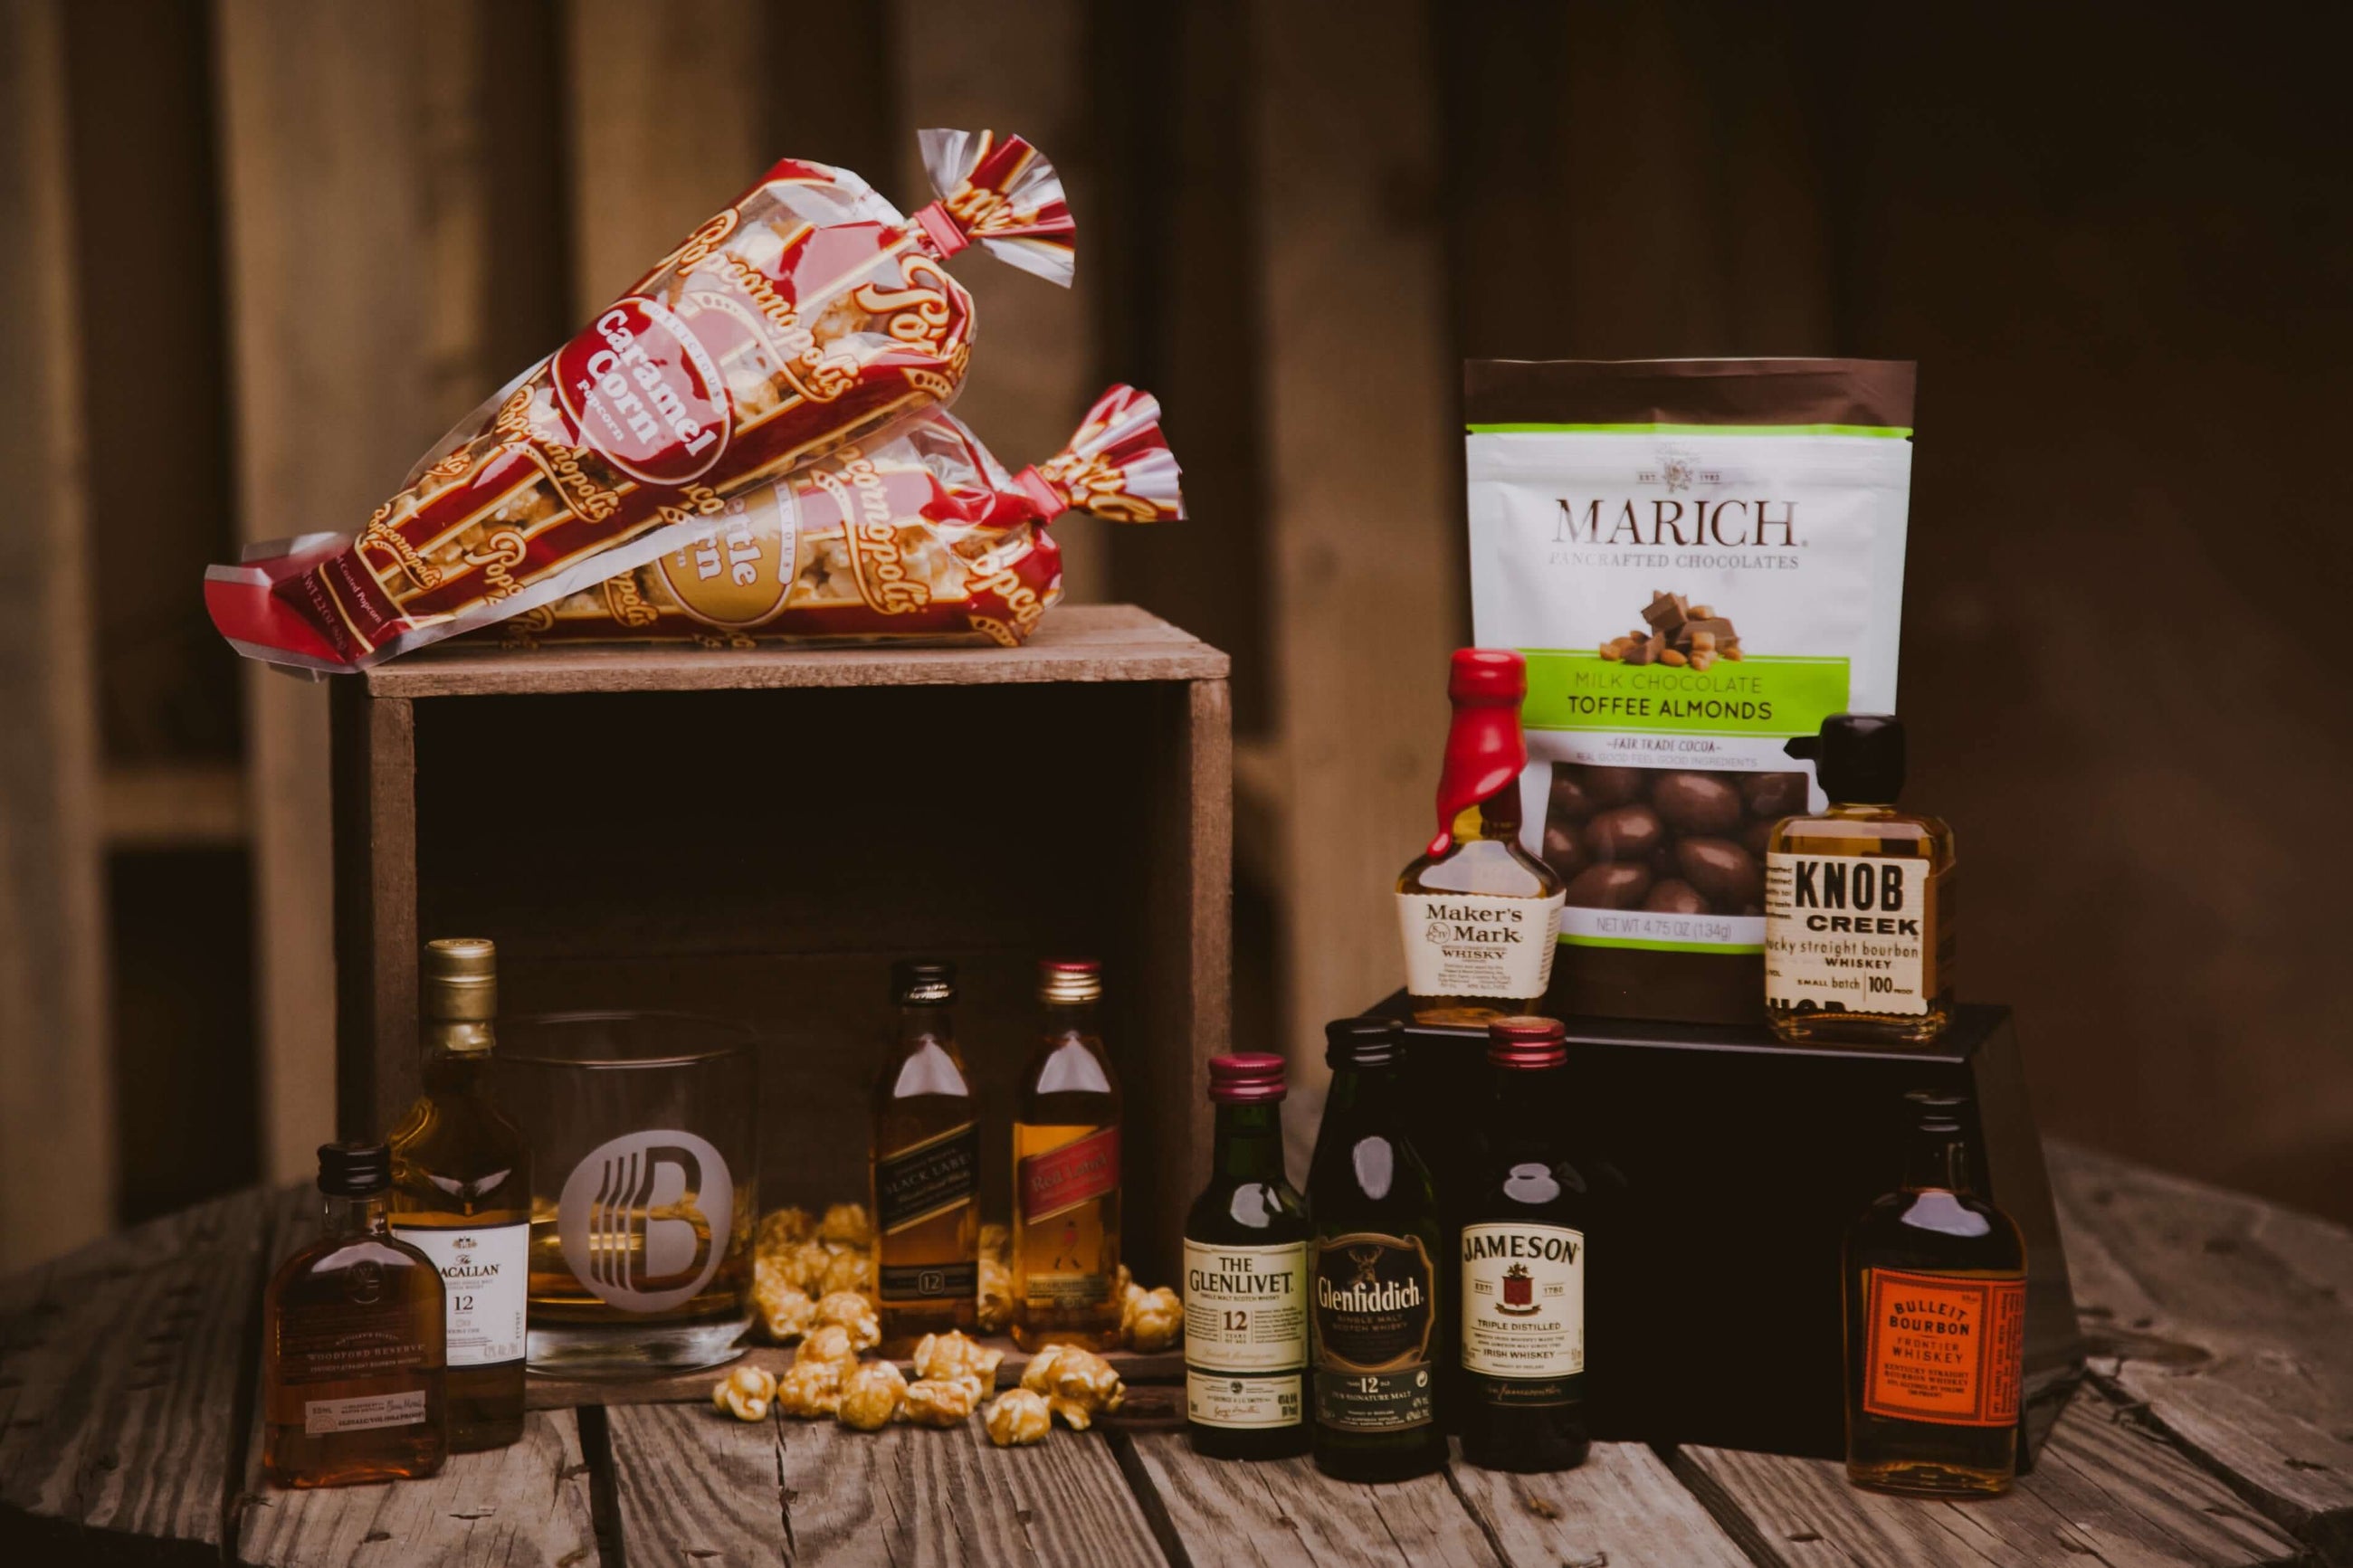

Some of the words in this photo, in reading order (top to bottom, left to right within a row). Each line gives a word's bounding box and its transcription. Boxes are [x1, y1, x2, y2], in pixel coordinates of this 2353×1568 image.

[595, 309, 718, 457] Caramel
[587, 349, 659, 444] Corn
[1551, 499, 1800, 546] MARICH
[1675, 554, 1799, 570] CHOCOLATES
[1576, 672, 1623, 689] MILK
[1632, 673, 1764, 694] CHOCOLATE
[1568, 696, 1652, 717] TOFFEE
[1659, 700, 1773, 721] ALMONDS
[1796, 861, 1903, 911] KNOB
[1426, 904, 1522, 922] Maker's
[1453, 926, 1520, 943] Mark
[1597, 917, 1618, 933] NET
[1622, 917, 1639, 934] WT
[1675, 921, 1691, 937] OZ
[1806, 915, 1920, 936] CREEK
[1441, 949, 1507, 960] WHISKY
[1801, 939, 1857, 957] straight
[1862, 941, 1920, 958] bourbon
[1825, 957, 1892, 970] WHISKEY
[1797, 979, 1827, 987] SMALL
[1832, 976, 1861, 990] batch
[1869, 976, 1893, 993] 100
[1464, 1235, 1577, 1265] JAMESON
[440, 1266, 499, 1278] ACALLAN
[1219, 1257, 1253, 1272] THE
[922, 1274, 941, 1292] 12
[1190, 1269, 1293, 1294] GLENLIVET
[453, 1296, 473, 1311] 12
[1319, 1276, 1420, 1312] Glenfiddich
[1224, 1310, 1248, 1330] 12
[1894, 1300, 1967, 1322] BULLEIT
[1478, 1318, 1509, 1330] TRIPLE
[1511, 1322, 1561, 1332] DISTILLED
[1889, 1316, 1970, 1335] BOURBON
[1483, 1348, 1508, 1357] IRISH
[1510, 1350, 1556, 1359] WHISKEY
[1892, 1345, 1963, 1365] WHISKEY
[1361, 1377, 1378, 1392] 12
